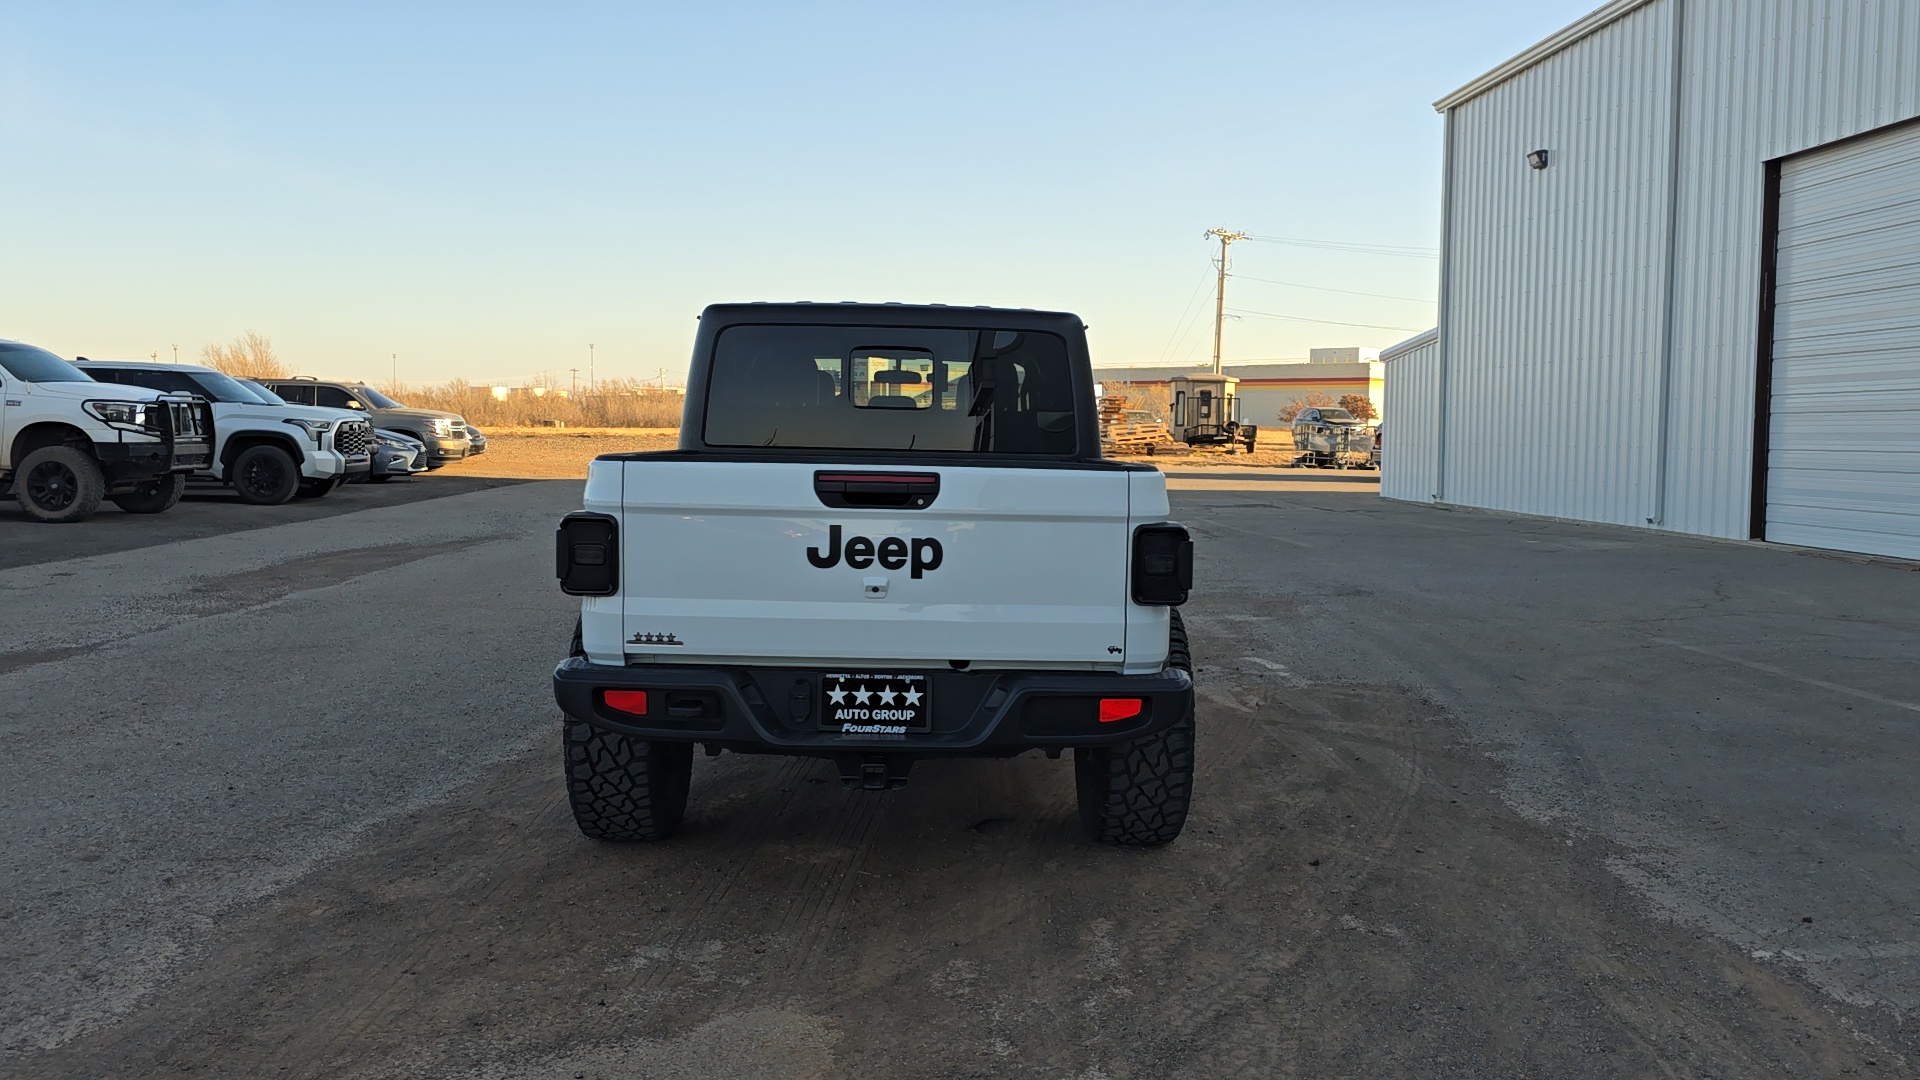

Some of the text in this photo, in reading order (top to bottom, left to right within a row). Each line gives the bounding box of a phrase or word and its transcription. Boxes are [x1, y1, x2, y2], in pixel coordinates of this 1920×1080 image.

[806, 524, 944, 580] Jeep
[834, 709, 915, 720] AUTO GROUP
